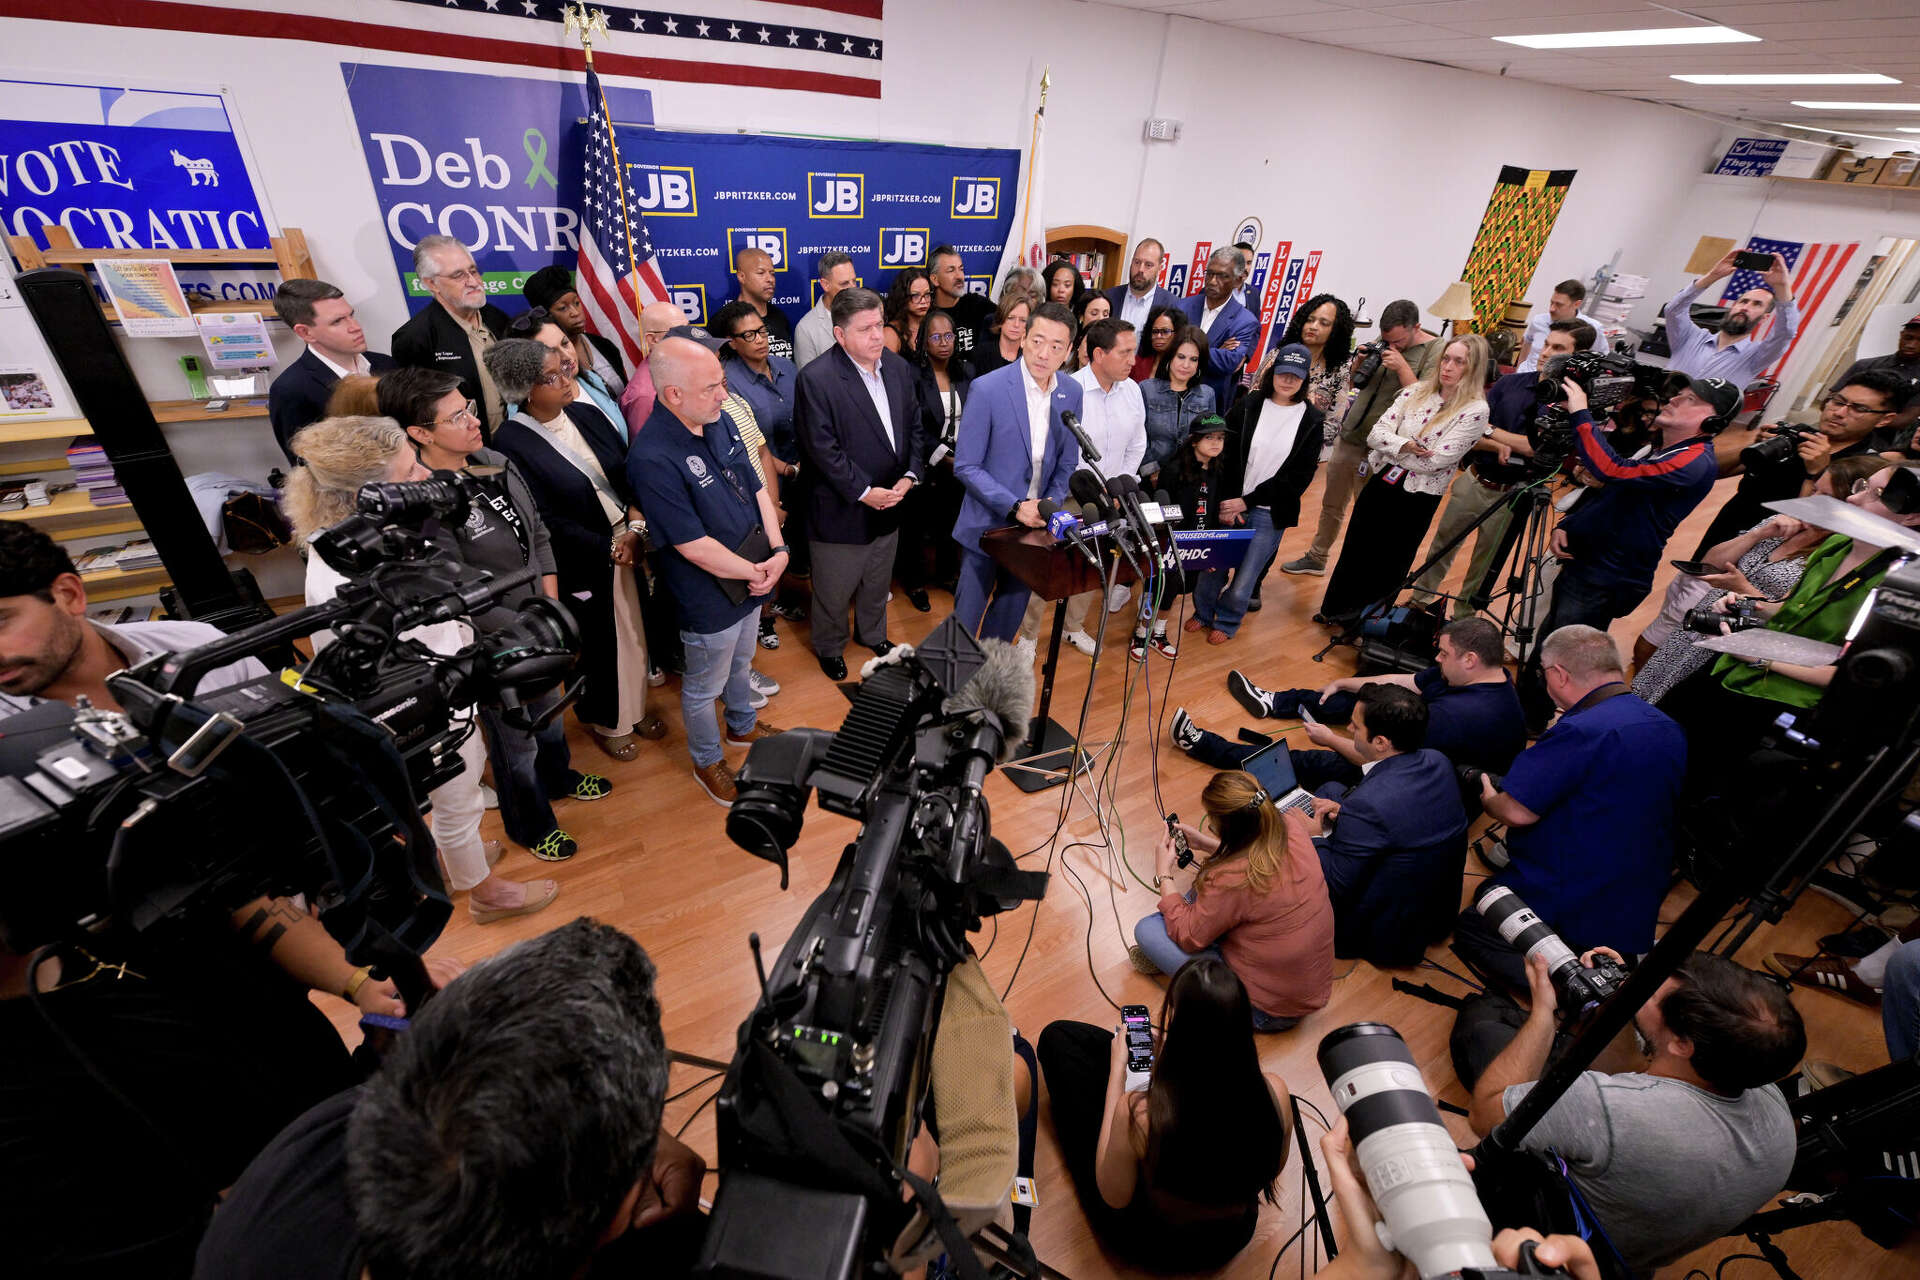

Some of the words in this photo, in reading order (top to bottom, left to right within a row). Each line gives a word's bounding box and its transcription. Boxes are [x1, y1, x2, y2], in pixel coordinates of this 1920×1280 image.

[370, 132, 511, 190] Deb
[1723, 158, 1755, 168] They
[637, 173, 690, 209] JB
[713, 191, 797, 200] JBPRITZKER.COM
[814, 180, 858, 212] JB
[871, 194, 941, 203] JBPRITZKER.COM
[955, 184, 995, 213] JB
[0, 206, 260, 249] OCRATIC
[655, 248, 719, 257] ITZKER.COM
[883, 234, 924, 264] JB
[1261, 245, 1287, 325] LISLE
[1276, 262, 1302, 324] YORK
